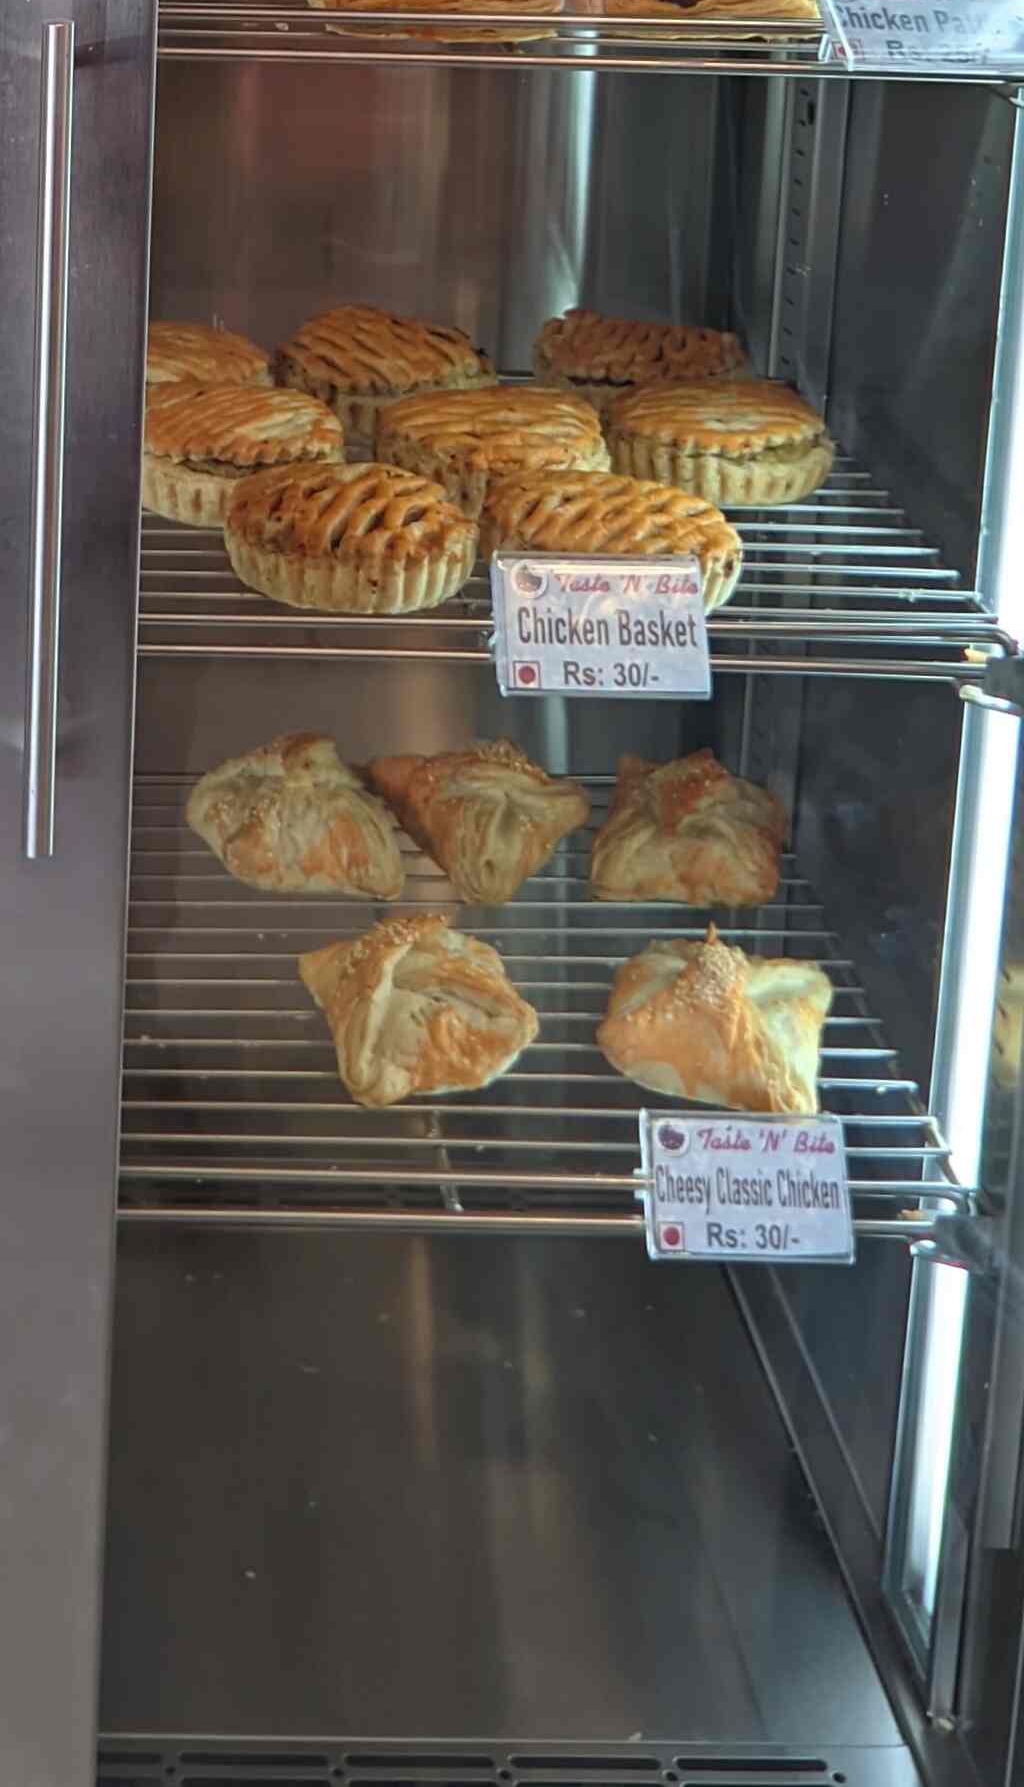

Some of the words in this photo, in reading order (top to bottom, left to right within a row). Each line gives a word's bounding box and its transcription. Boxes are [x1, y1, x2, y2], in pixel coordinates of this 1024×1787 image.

[553, 571, 610, 593] Taste
[655, 573, 699, 595] Bite
[517, 606, 610, 646] Chicken
[617, 610, 697, 647] Basket
[563, 661, 604, 686] Rs:
[613, 663, 659, 687] 30/-
[696, 1126, 752, 1151] Taste
[793, 1131, 836, 1154] Bite
[656, 1164, 712, 1214] Cheesy
[715, 1167, 773, 1207] Classic
[776, 1168, 840, 1210] Chicken
[706, 1222, 747, 1248] Rs:
[755, 1224, 801, 1250] 30/-
